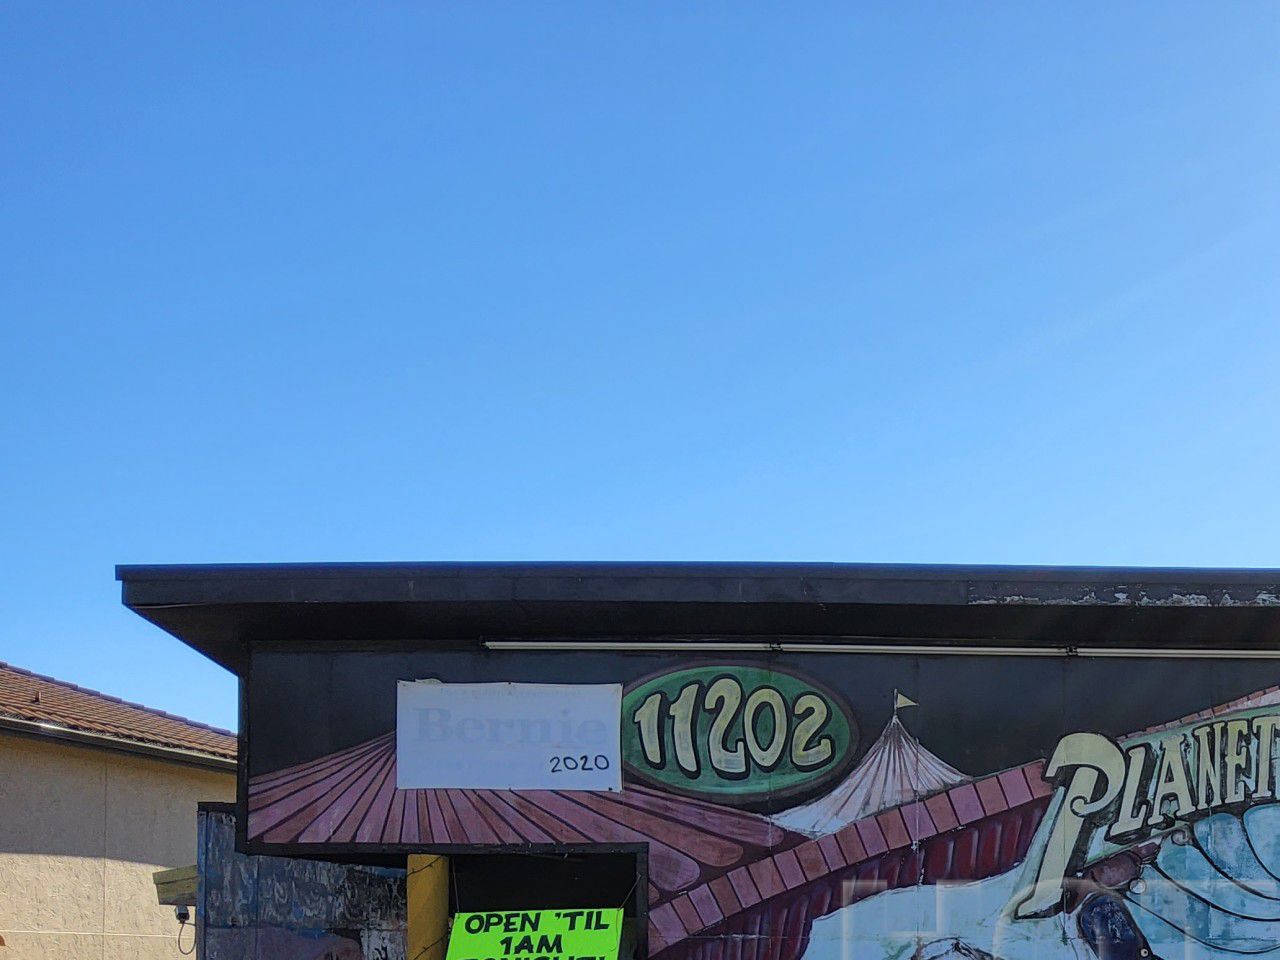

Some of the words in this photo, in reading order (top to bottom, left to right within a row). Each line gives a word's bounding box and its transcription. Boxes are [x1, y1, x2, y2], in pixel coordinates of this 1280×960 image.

[412, 707, 608, 743] Bernie
[634, 677, 835, 780] 11202
[549, 754, 609, 774] 2020
[464, 912, 541, 935] OPEN
[500, 934, 563, 955] 1AM
